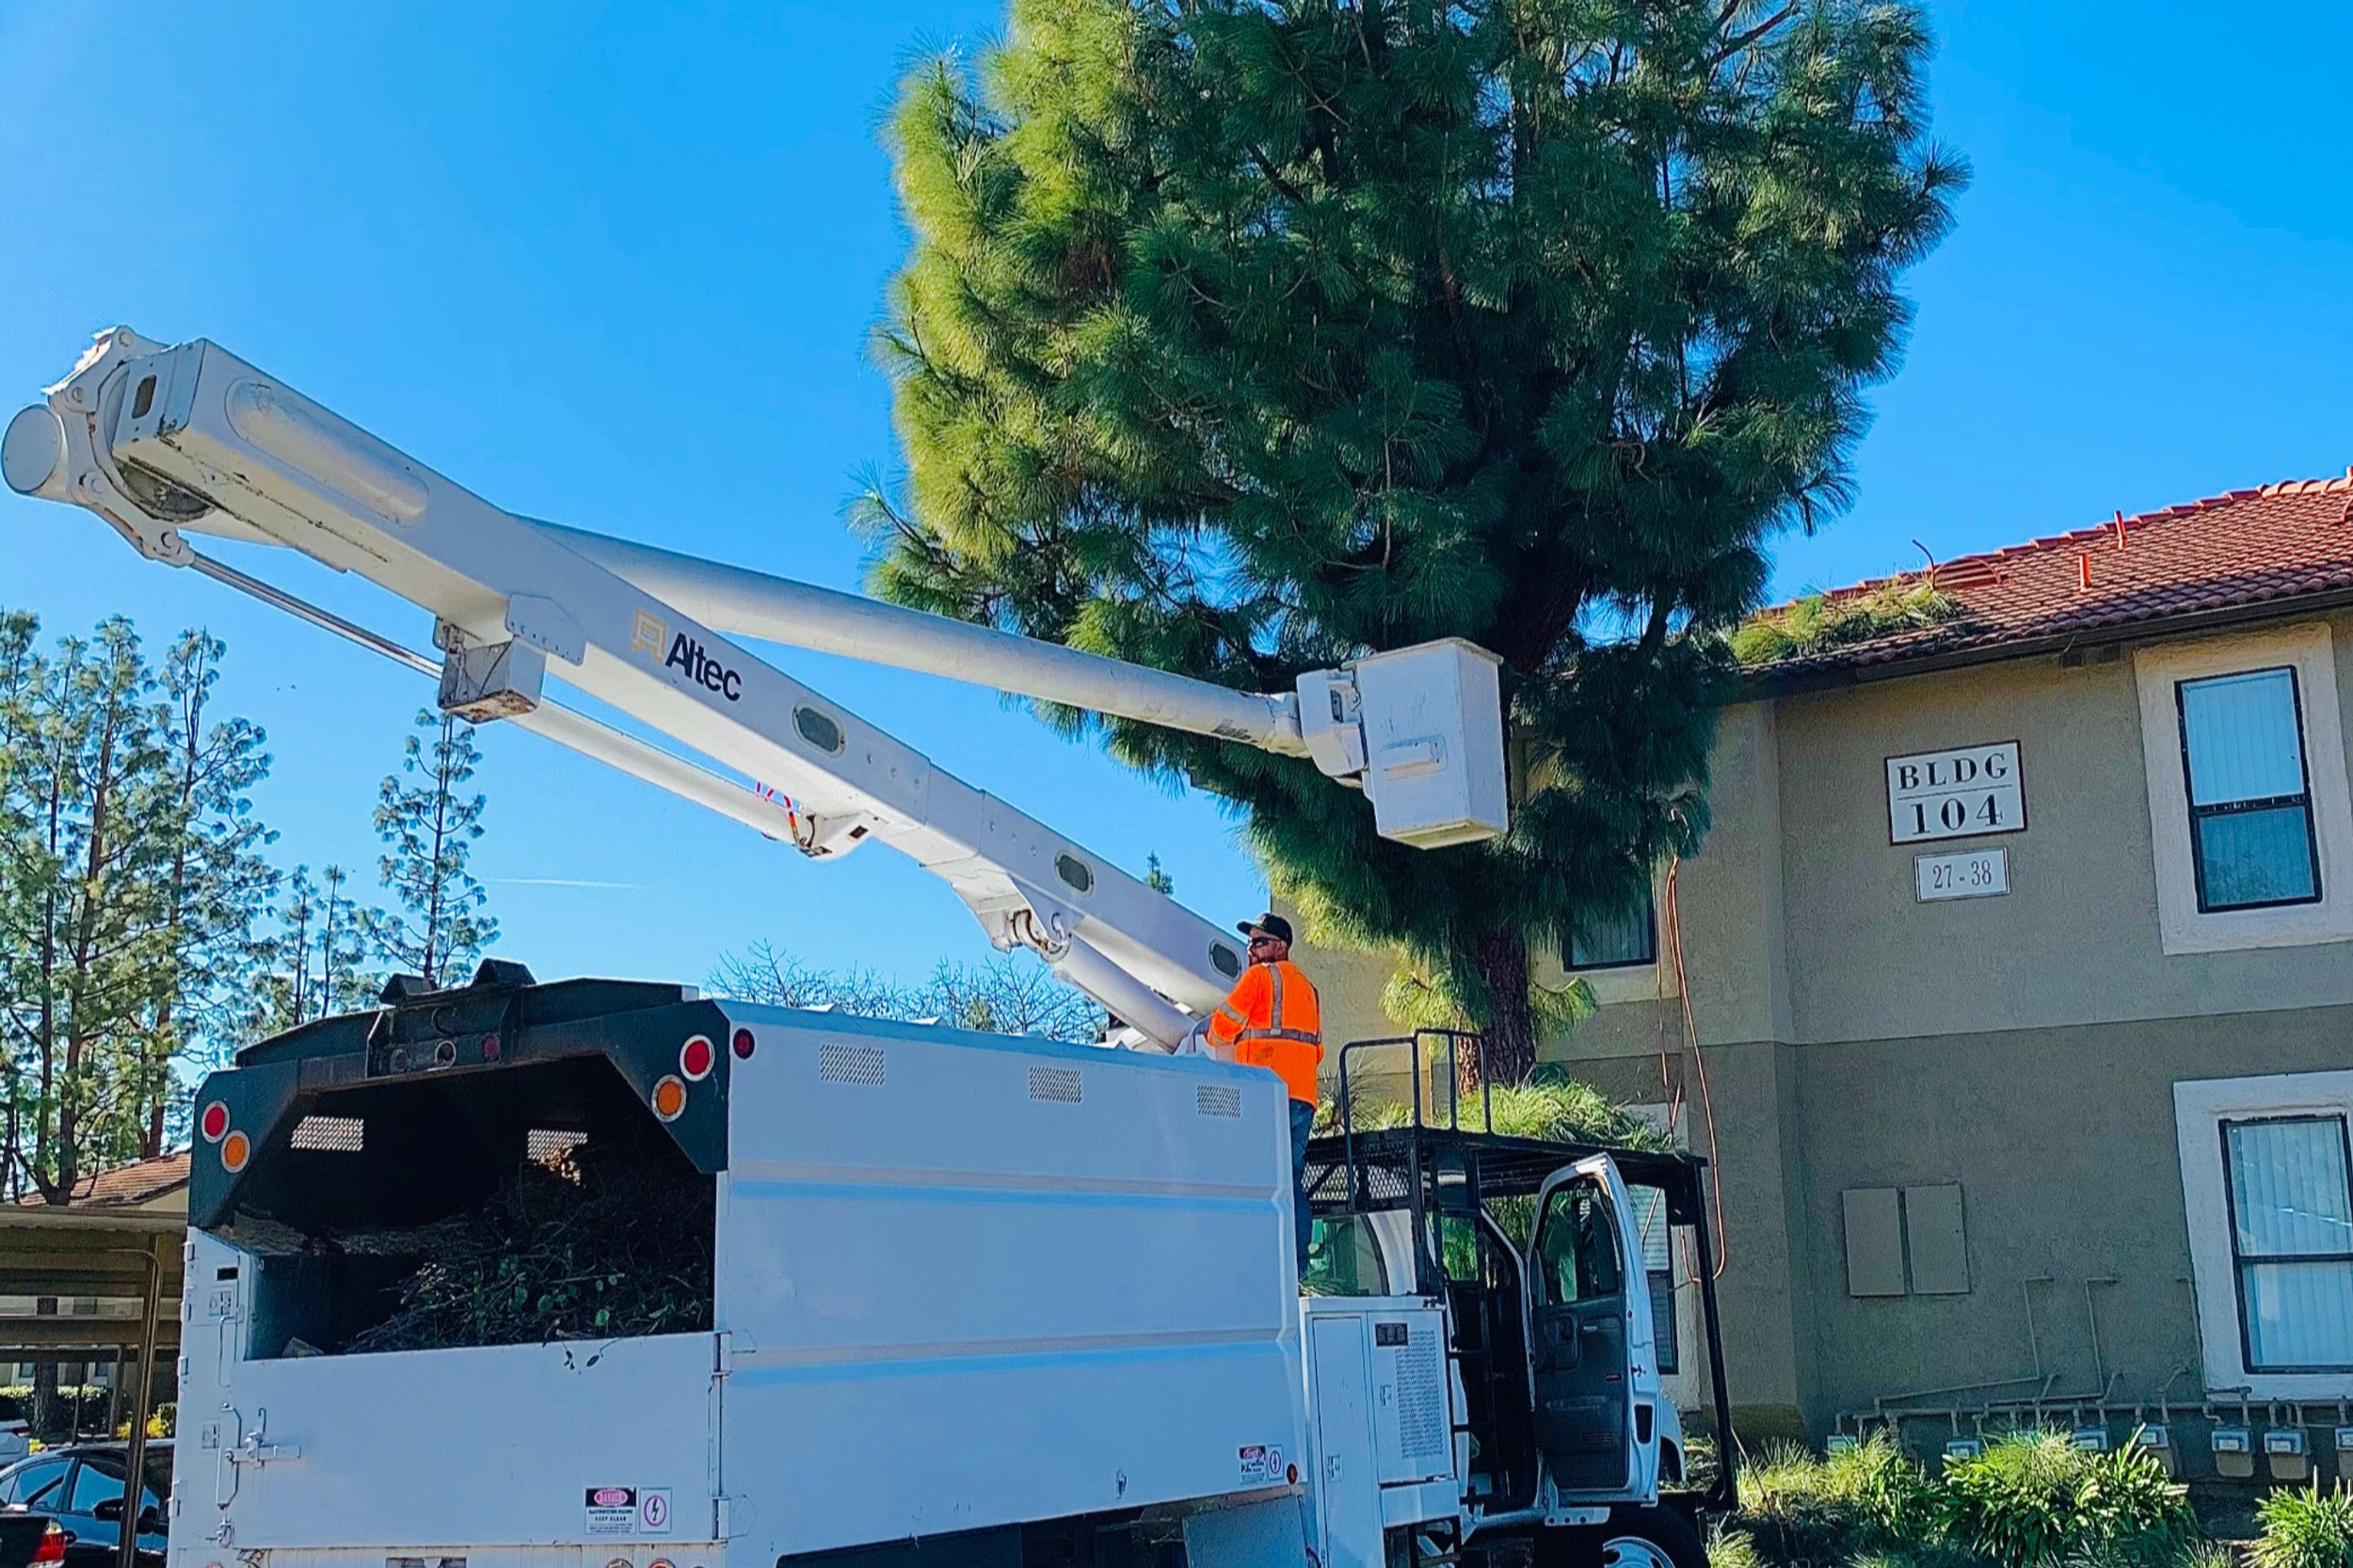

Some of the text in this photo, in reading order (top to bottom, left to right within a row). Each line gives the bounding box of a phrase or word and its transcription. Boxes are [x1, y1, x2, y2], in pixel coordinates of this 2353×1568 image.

[664, 632, 742, 701] Altec
[1897, 753, 2009, 791] BLDG
[1910, 793, 2003, 835] 104
